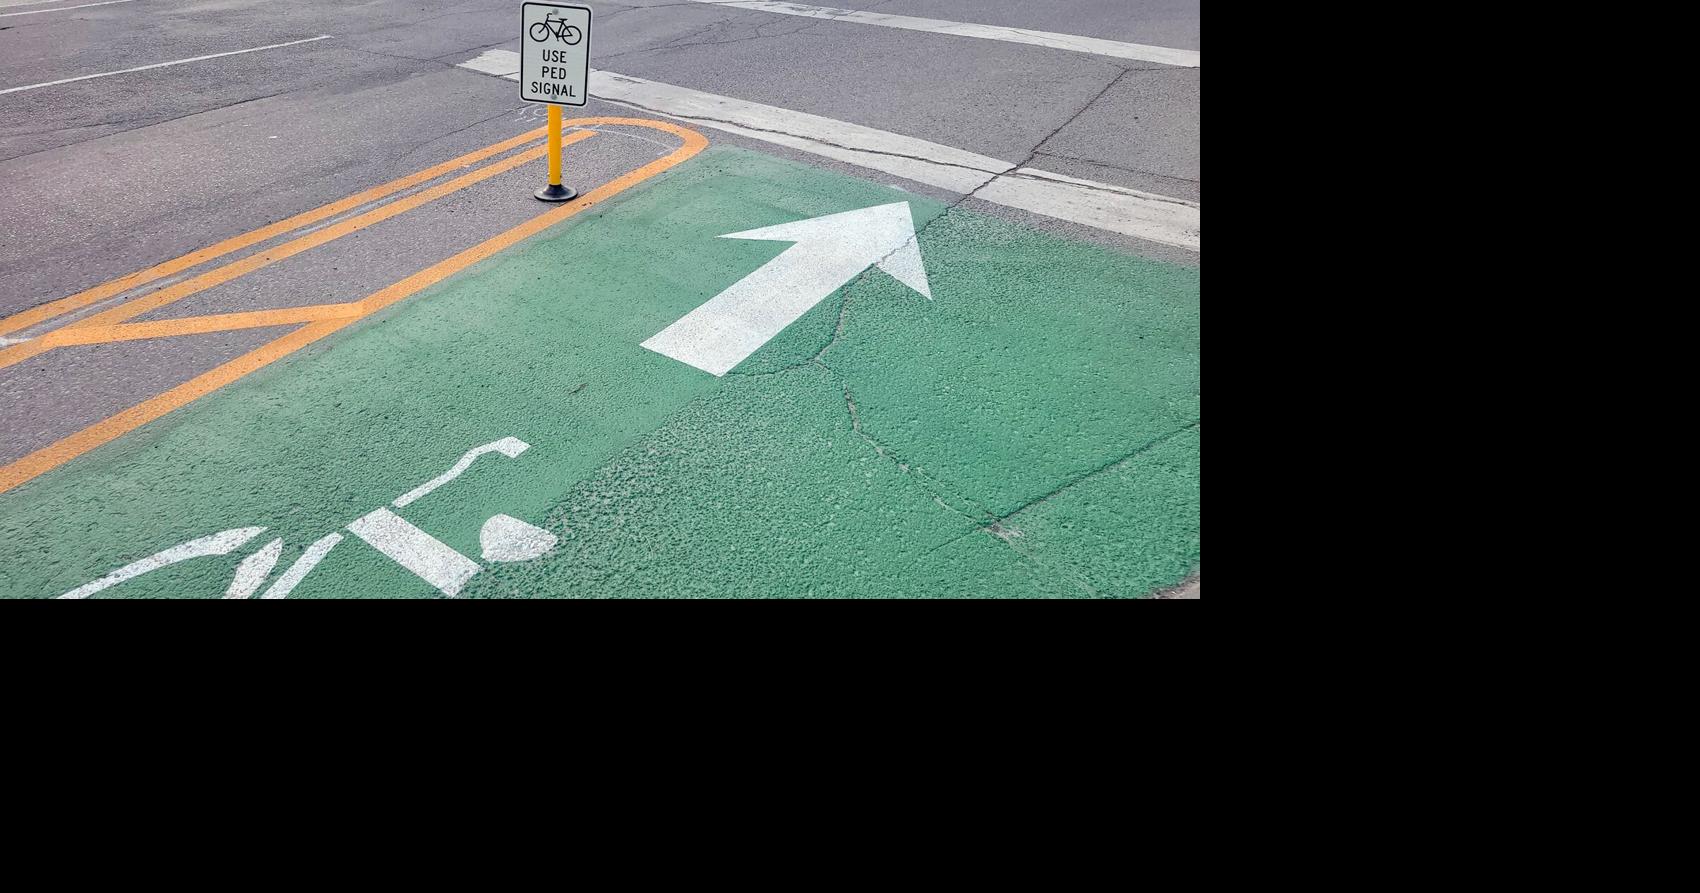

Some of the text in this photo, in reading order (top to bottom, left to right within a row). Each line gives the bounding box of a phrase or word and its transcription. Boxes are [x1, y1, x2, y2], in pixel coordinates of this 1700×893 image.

[542, 49, 567, 63] USE
[541, 66, 567, 79] PED
[531, 81, 576, 97] SIGNAL
